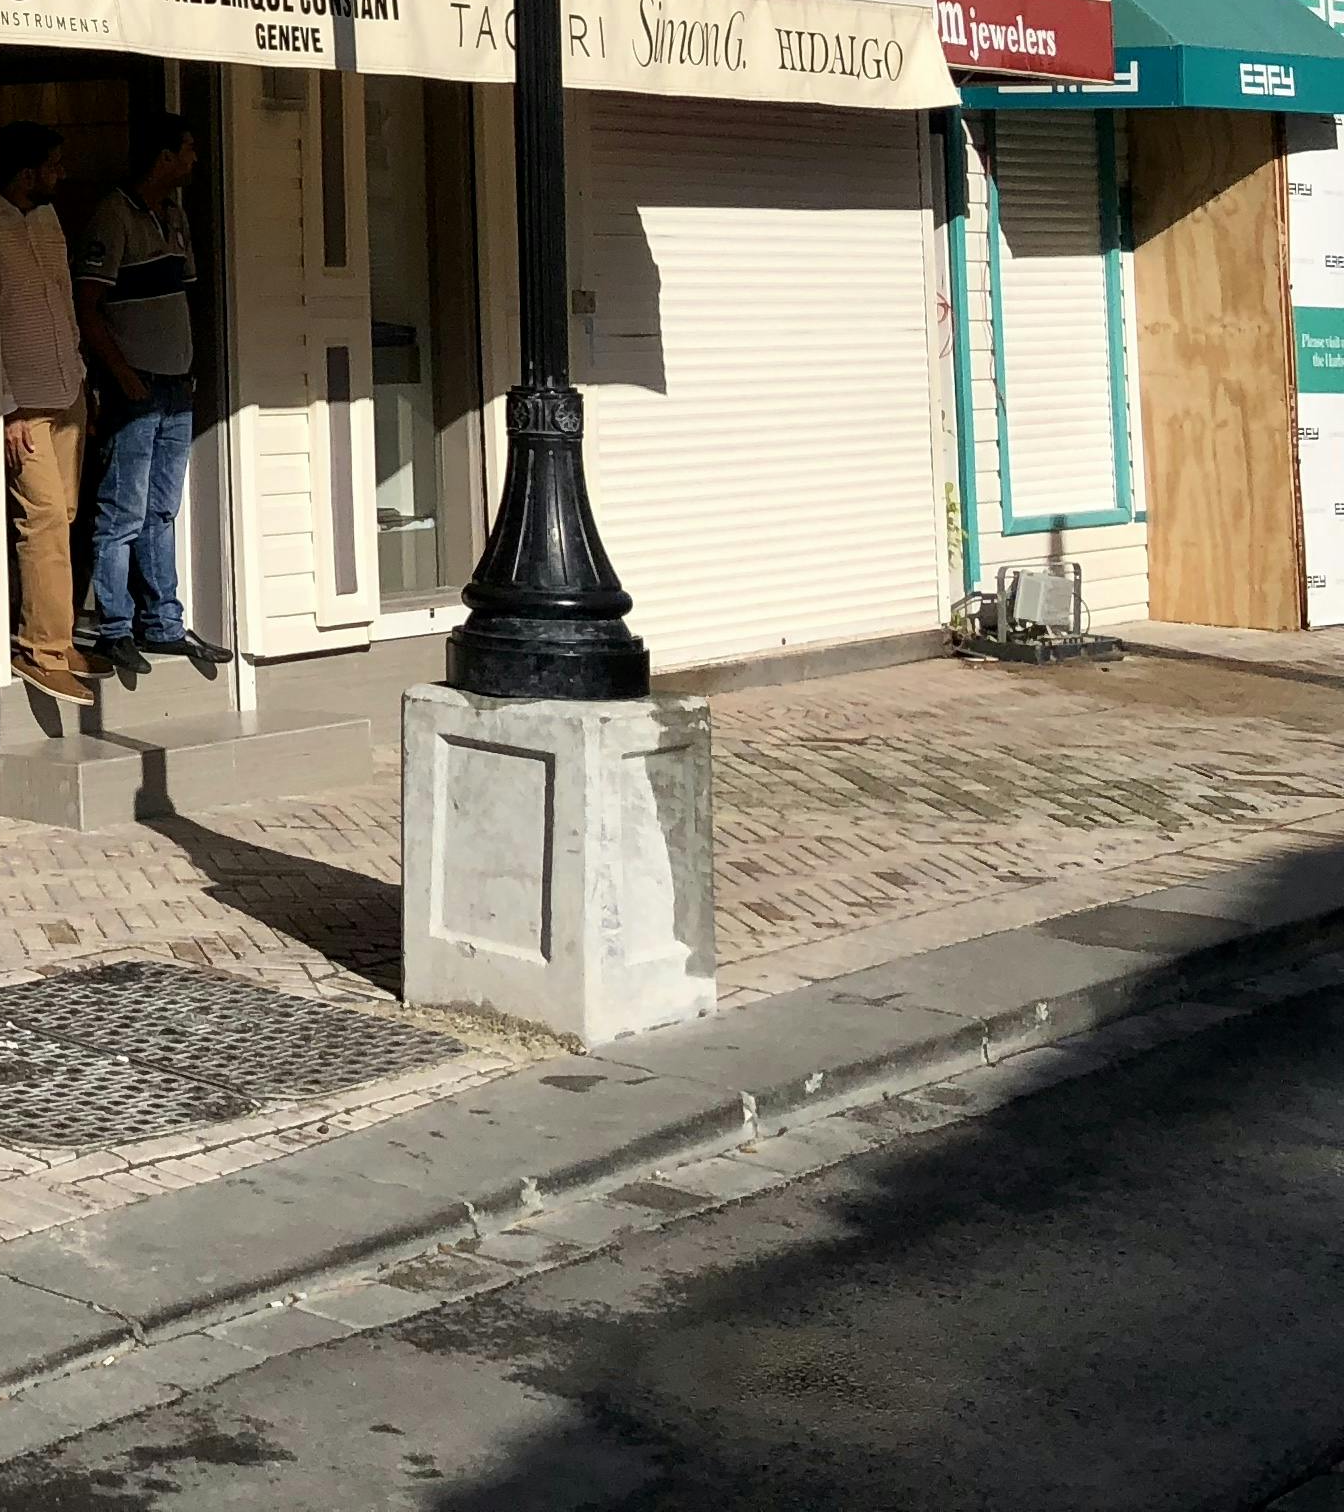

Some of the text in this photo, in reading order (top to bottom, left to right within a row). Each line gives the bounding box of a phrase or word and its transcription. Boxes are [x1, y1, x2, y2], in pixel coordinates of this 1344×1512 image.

[254, 22, 325, 54] GENEVE
[450, 2, 608, 60] TARI
[774, 27, 905, 82] HIDALGO
[934, 0, 1057, 62] m jewelers
